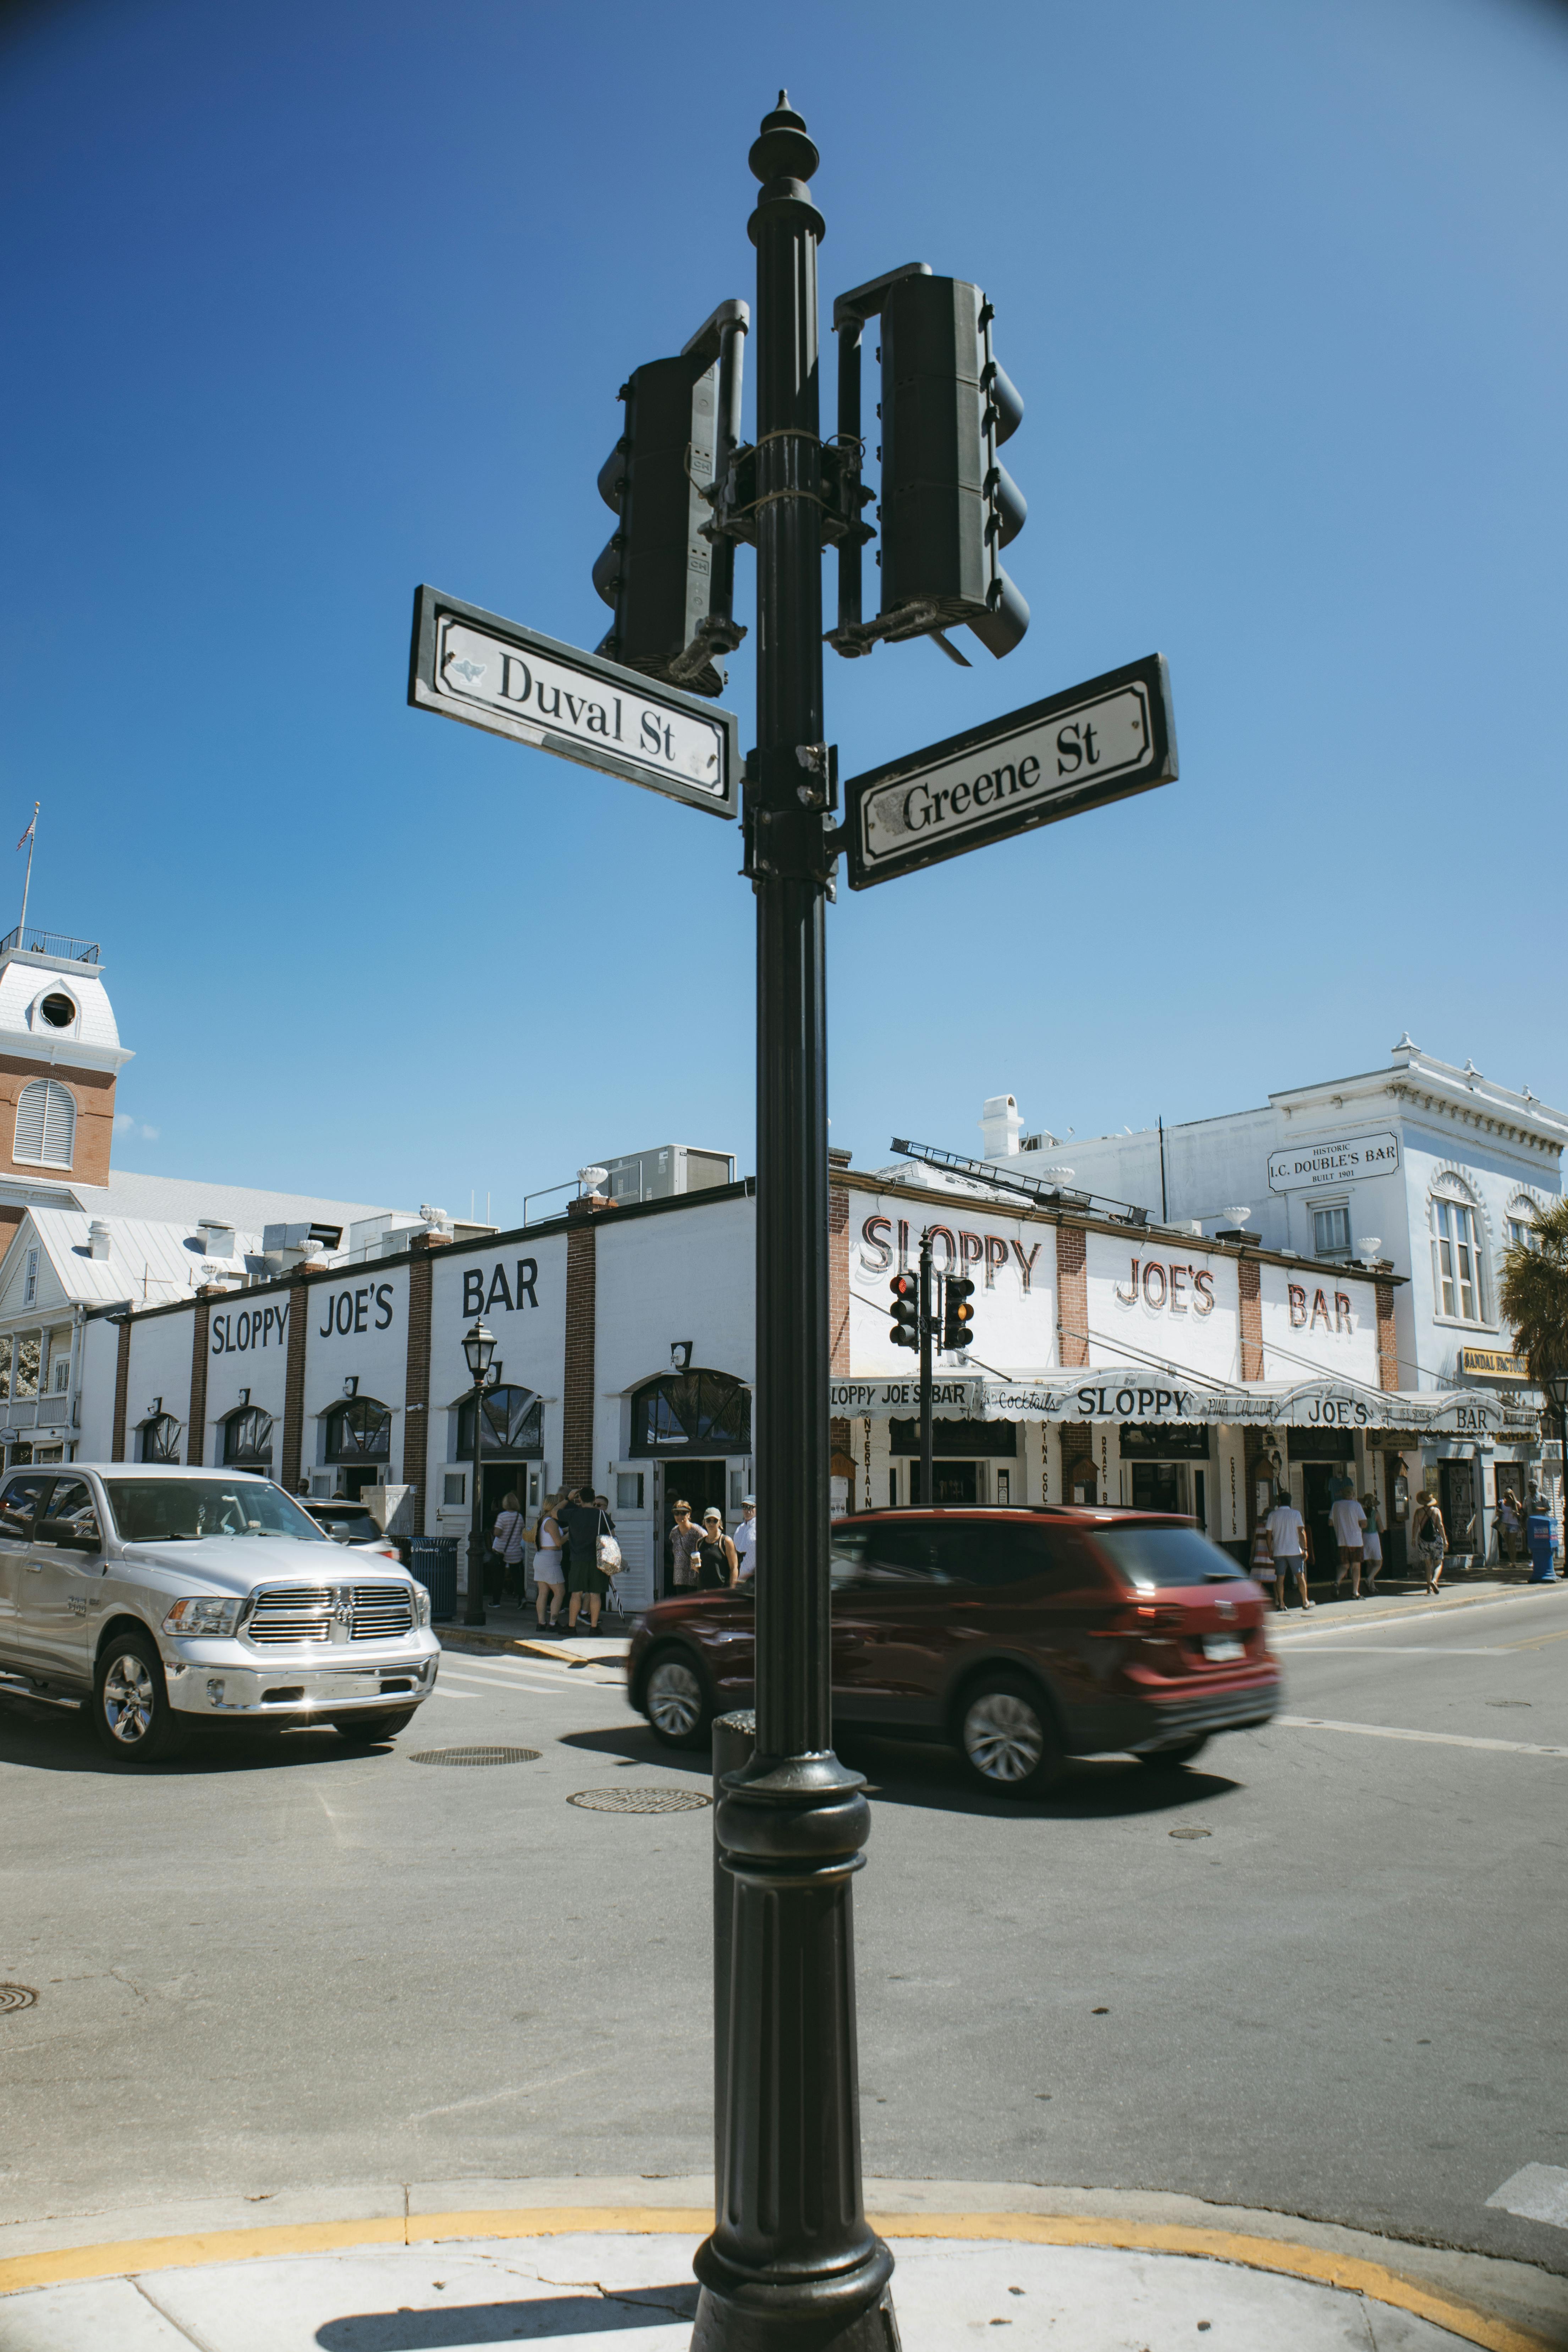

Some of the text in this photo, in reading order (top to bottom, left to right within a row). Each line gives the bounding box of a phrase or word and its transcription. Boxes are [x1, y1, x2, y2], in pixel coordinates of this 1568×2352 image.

[498, 652, 675, 761] Duval St
[903, 722, 1100, 831] Greene St
[1271, 1146, 1395, 1177] I.C. DOUBLE'S BAR
[1313, 1144, 1350, 1156] HISTORIC
[1313, 1170, 1354, 1182] BUILT 1901
[860, 1215, 1043, 1295] SLOPPY
[462, 1258, 539, 1318] BAR
[1116, 1258, 1216, 1317] JOE'S
[320, 1282, 394, 1338] JOE'S
[1288, 1284, 1354, 1335] BAR
[212, 1302, 290, 1354] SLOPPY
[1464, 1352, 1495, 1370] SANDAL
[830, 1384, 965, 1405] LOPPY JOE'S BAR
[999, 1390, 1060, 1411] Cocktails
[1078, 1387, 1189, 1416] SLOPPY
[1308, 1400, 1366, 1424] JOE'S
[1457, 1408, 1487, 1429] BAR
[1499, 1431, 1532, 1441] OUTLET
